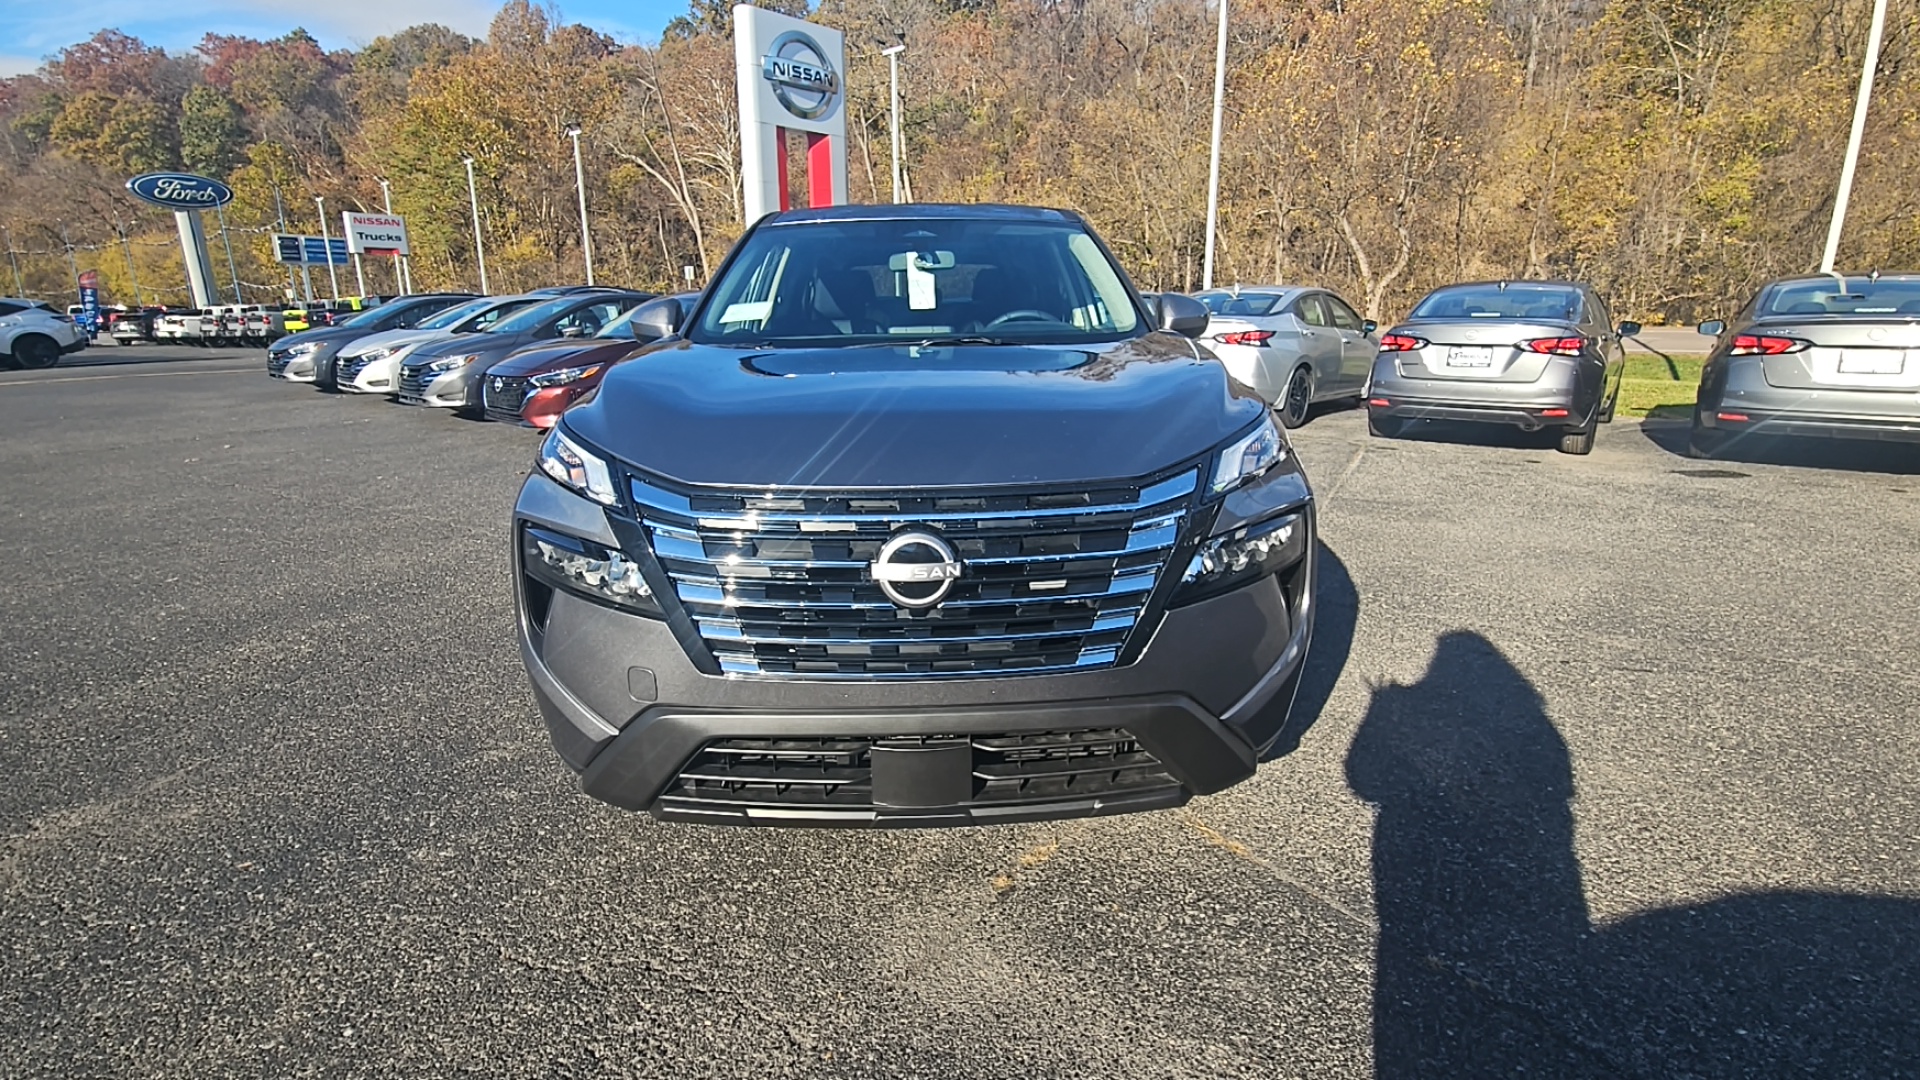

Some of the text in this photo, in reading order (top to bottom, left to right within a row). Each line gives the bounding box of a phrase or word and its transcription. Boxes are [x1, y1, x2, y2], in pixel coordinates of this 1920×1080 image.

[773, 61, 833, 87] NISSAN
[153, 178, 215, 201] Ford
[353, 216, 400, 227] NISSAN
[356, 231, 402, 242] Trucks
[876, 564, 961, 578] SAN
